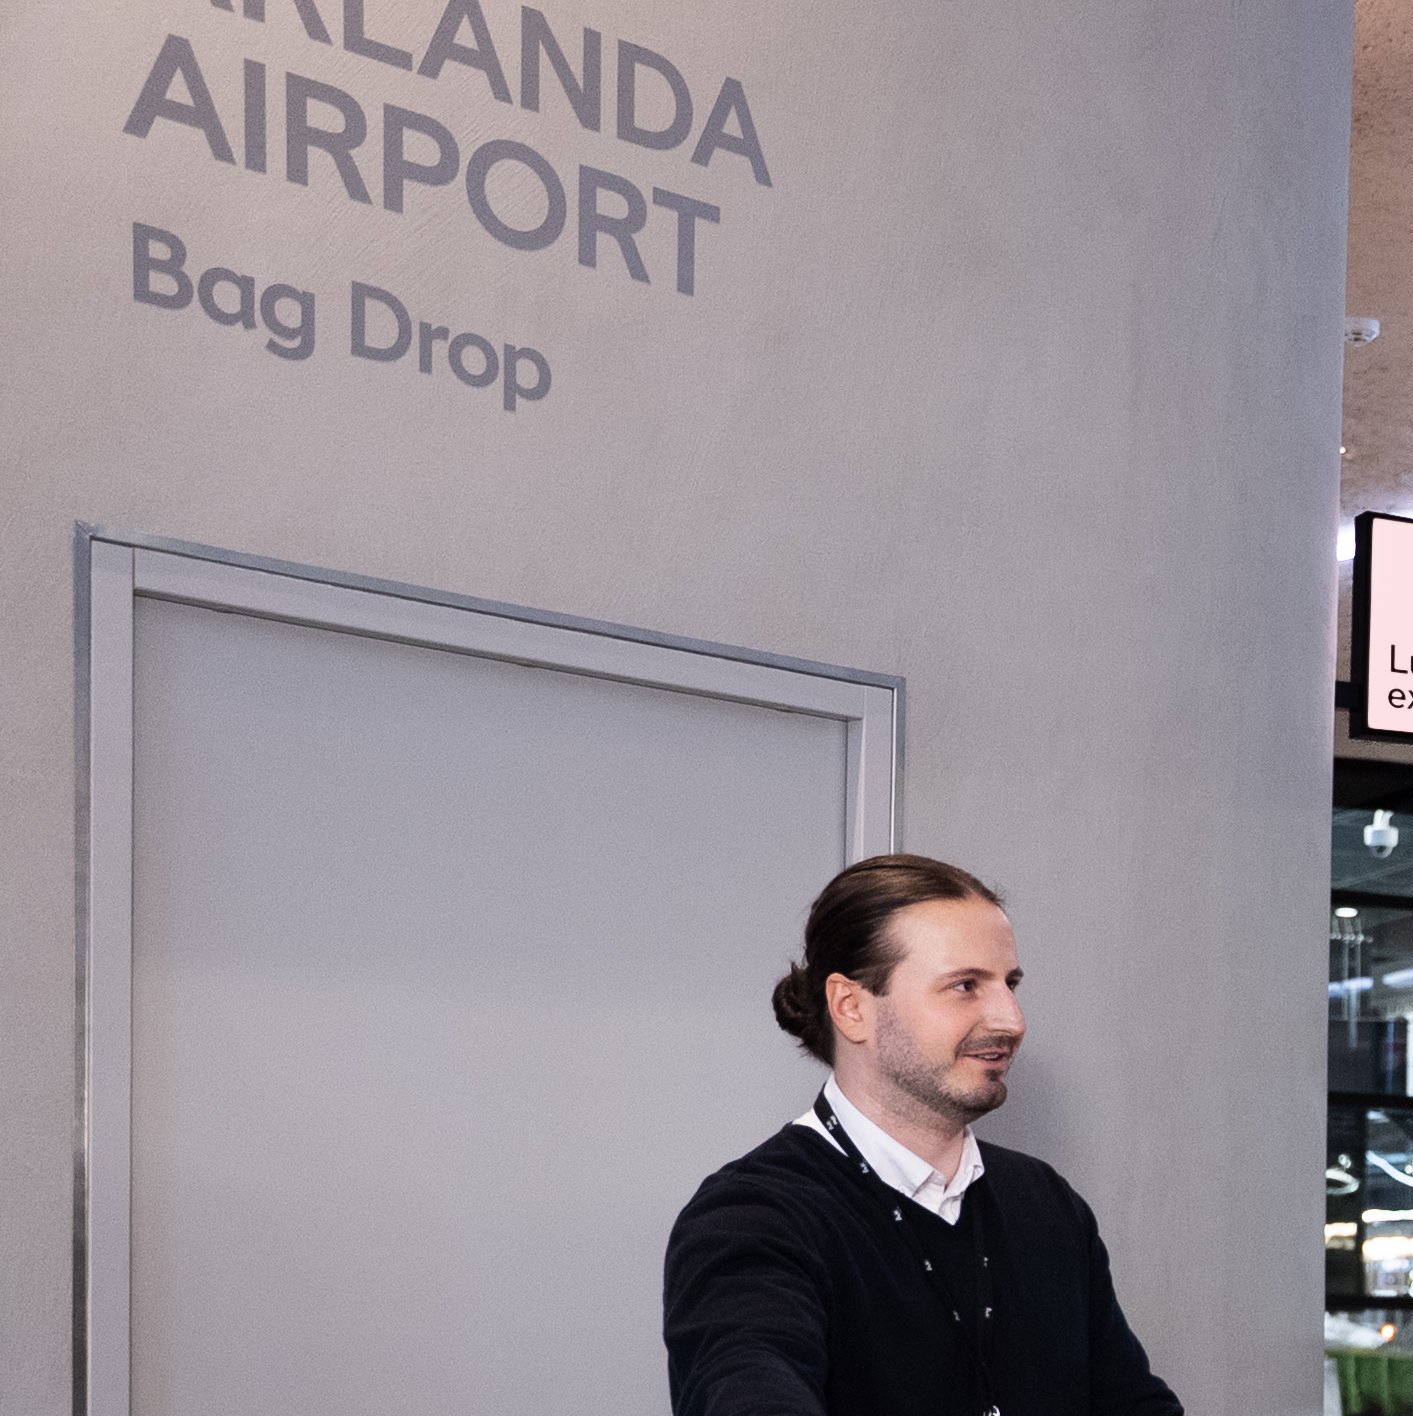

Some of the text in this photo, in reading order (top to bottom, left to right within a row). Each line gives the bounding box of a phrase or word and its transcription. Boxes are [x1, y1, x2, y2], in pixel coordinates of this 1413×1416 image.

[123, 34, 722, 297] AIRPORT
[209, 0, 774, 189] LANDA
[131, 221, 553, 413] Bag Drop
